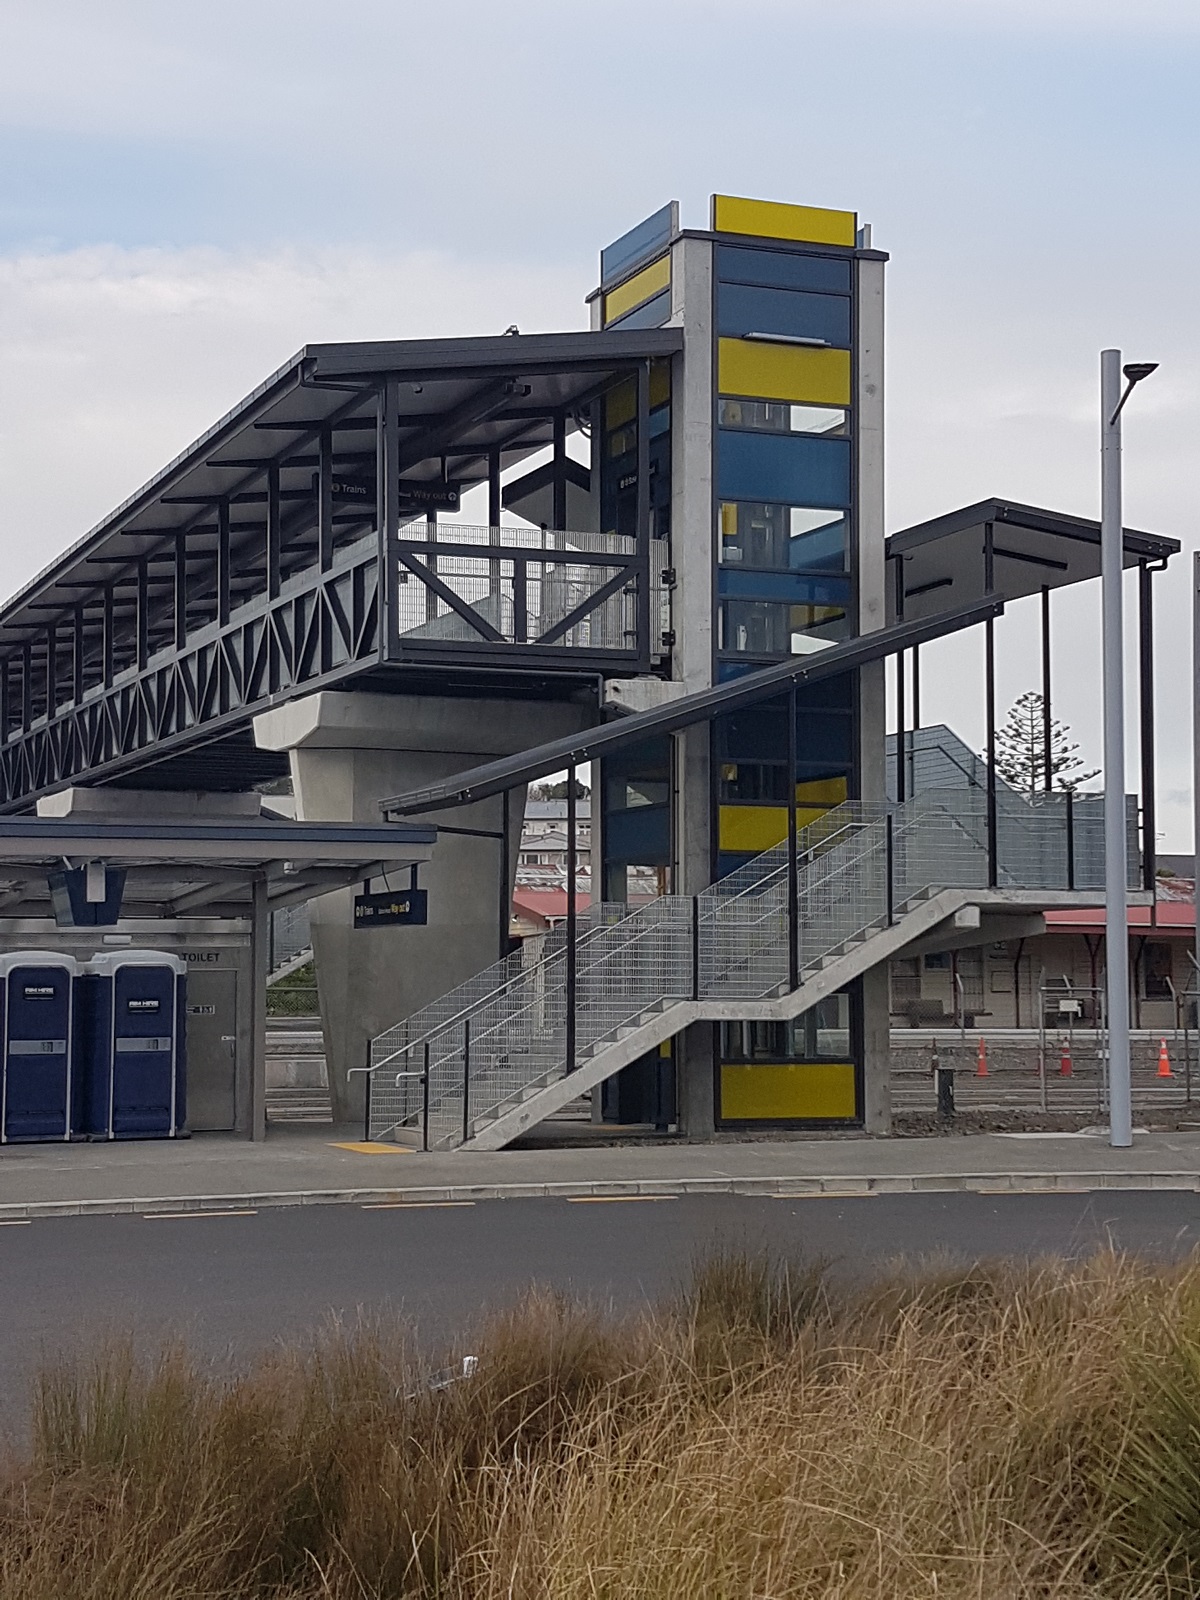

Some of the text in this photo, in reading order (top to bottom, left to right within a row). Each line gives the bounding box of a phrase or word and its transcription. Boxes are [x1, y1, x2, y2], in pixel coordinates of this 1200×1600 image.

[342, 483, 367, 495] Trains
[412, 489, 431, 502] Way
[181, 952, 220, 962] TOILET
